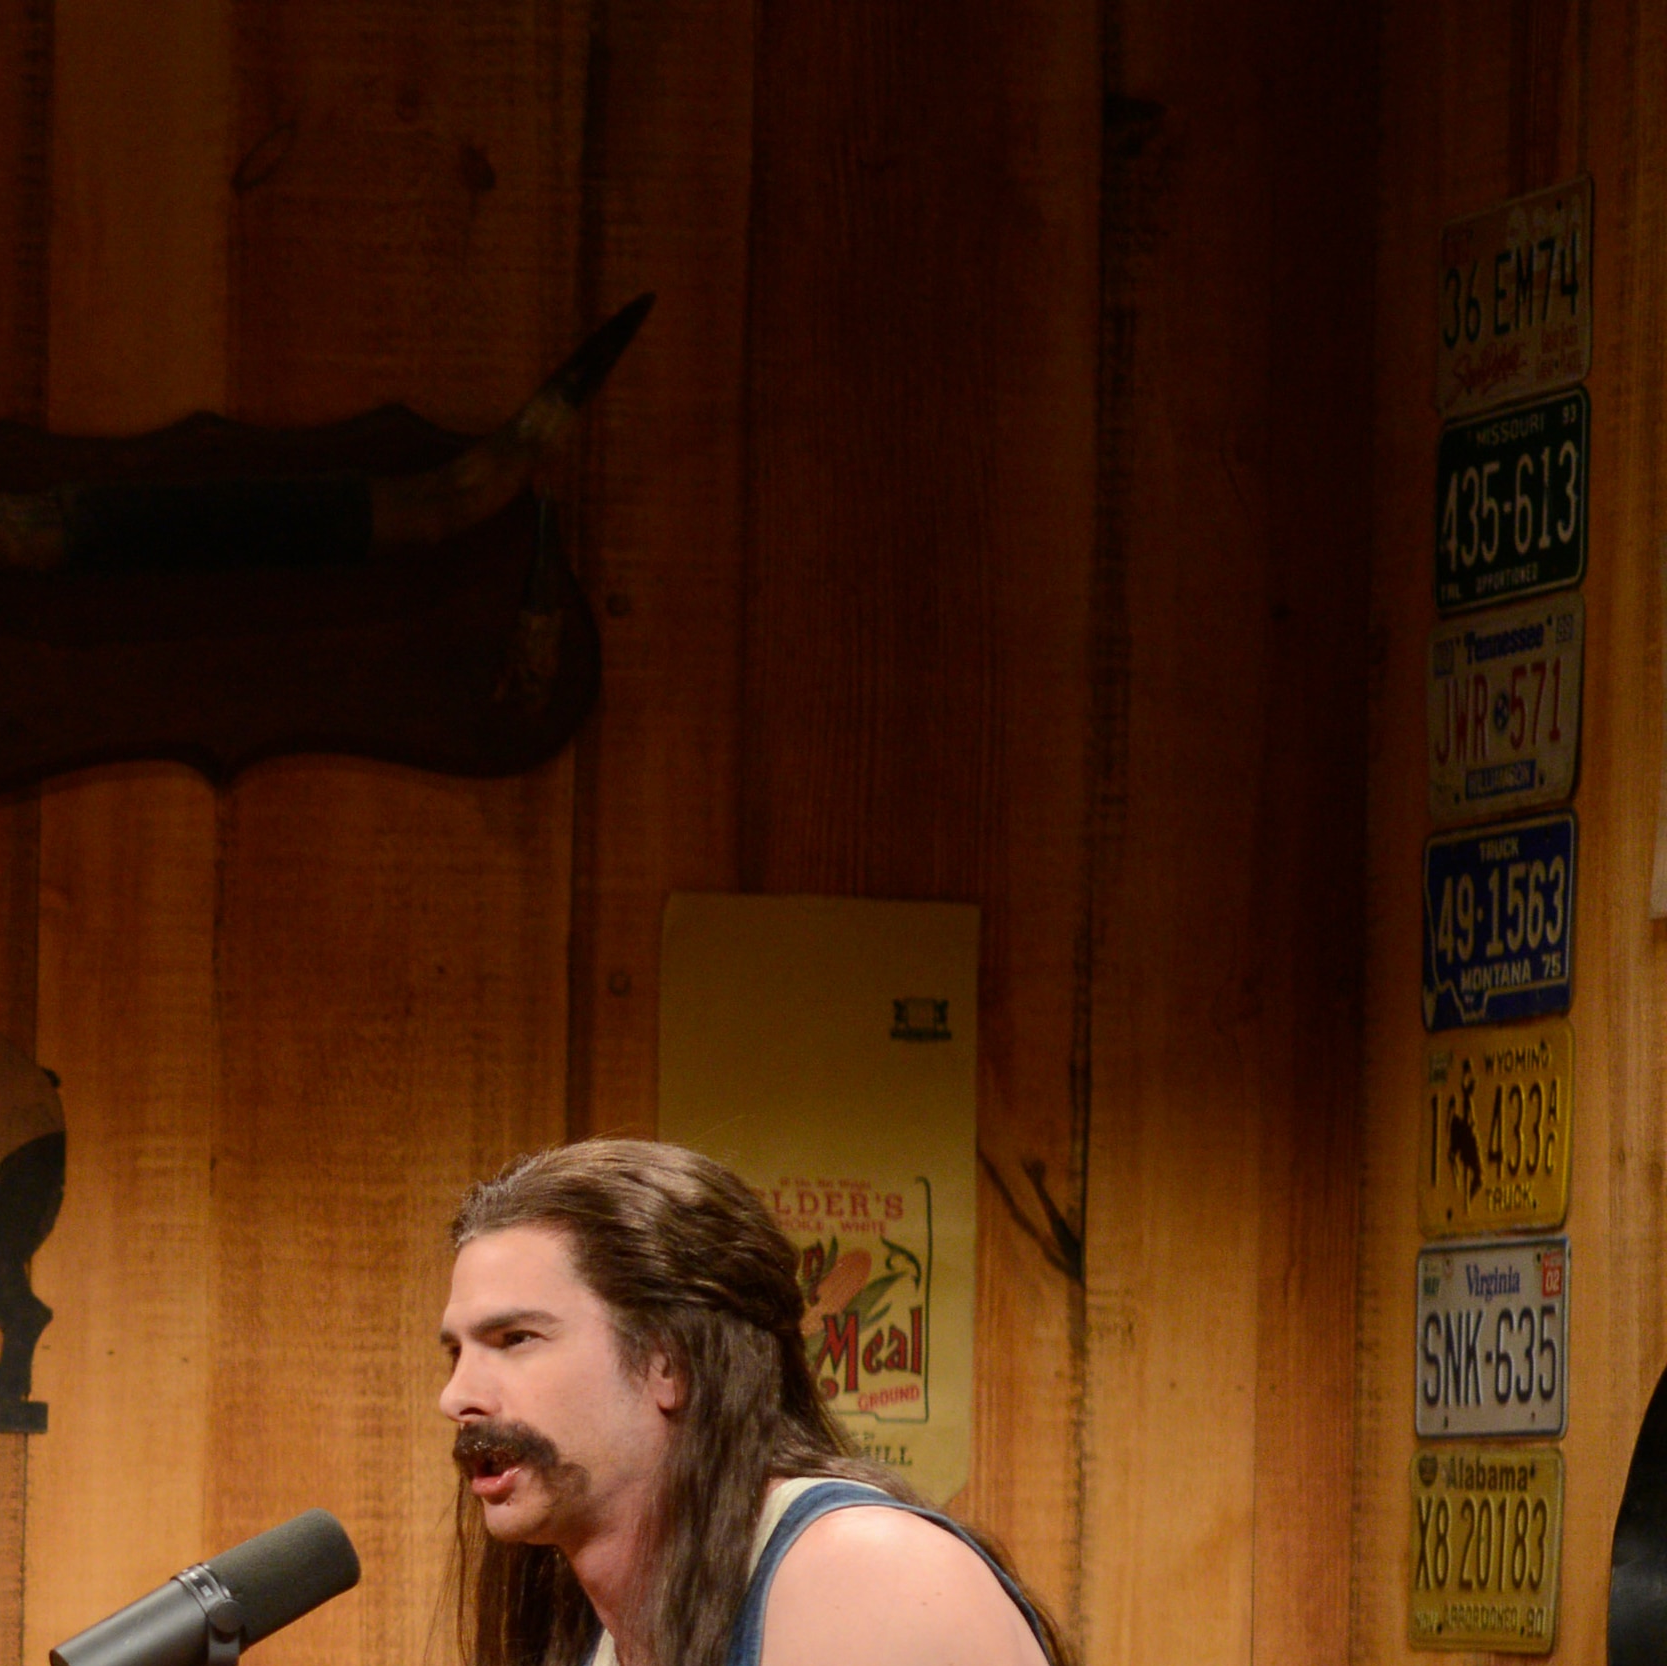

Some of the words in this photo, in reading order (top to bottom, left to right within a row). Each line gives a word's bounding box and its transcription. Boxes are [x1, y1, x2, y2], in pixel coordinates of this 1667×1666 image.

[1443, 260, 1481, 348] 36
[1494, 232, 1578, 334] EM74
[1475, 411, 1546, 448] MISSOURI
[1440, 439, 1578, 572] 435-613
[1465, 623, 1544, 665] Tennessee
[1435, 674, 1488, 766] JWR
[1510, 656, 1562, 750] 571
[1478, 836, 1520, 862] TRUCK
[1460, 957, 1532, 993] MONTANA
[1541, 949, 1562, 979] 75
[1485, 1044, 1550, 1073] WYOMING
[1488, 1082, 1544, 1180] 433
[755, 1189, 904, 1220] LDER'S
[1485, 1183, 1534, 1211] TRUCK
[1465, 1263, 1521, 1302] Virginia
[1545, 1269, 1560, 1293] 02
[815, 1305, 923, 1393] Meal
[1424, 1304, 1557, 1407] SNK-635
[858, 1384, 921, 1412] GROUND
[1446, 1455, 1529, 1492] Alabama
[1459, 1497, 1548, 1592] 20183
